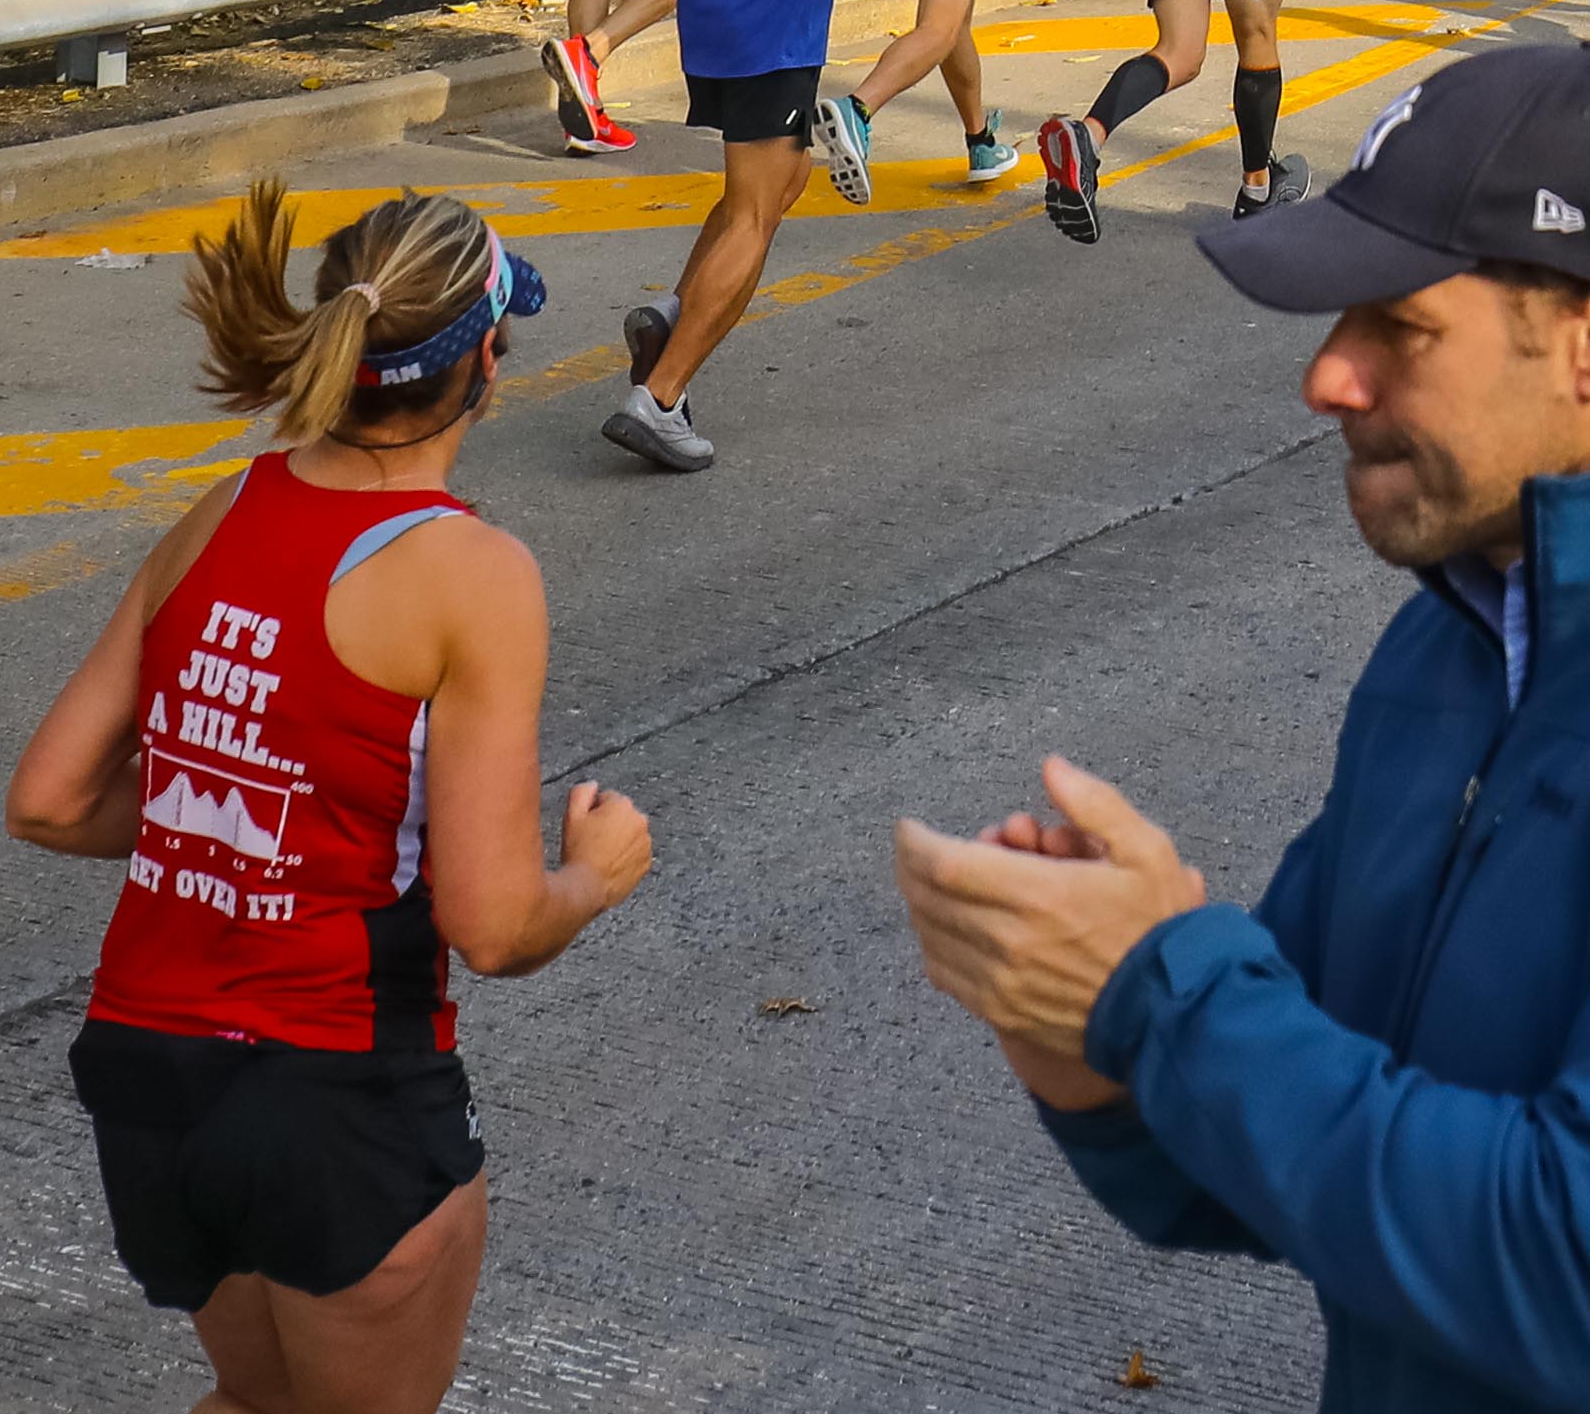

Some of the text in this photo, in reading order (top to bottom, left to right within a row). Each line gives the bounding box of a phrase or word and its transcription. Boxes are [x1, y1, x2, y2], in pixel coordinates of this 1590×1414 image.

[201, 600, 281, 660] IT'S
[178, 649, 281, 714] JUST
[147, 691, 306, 776] A HILL...
[129, 850, 295, 921] GET OVER IT!
